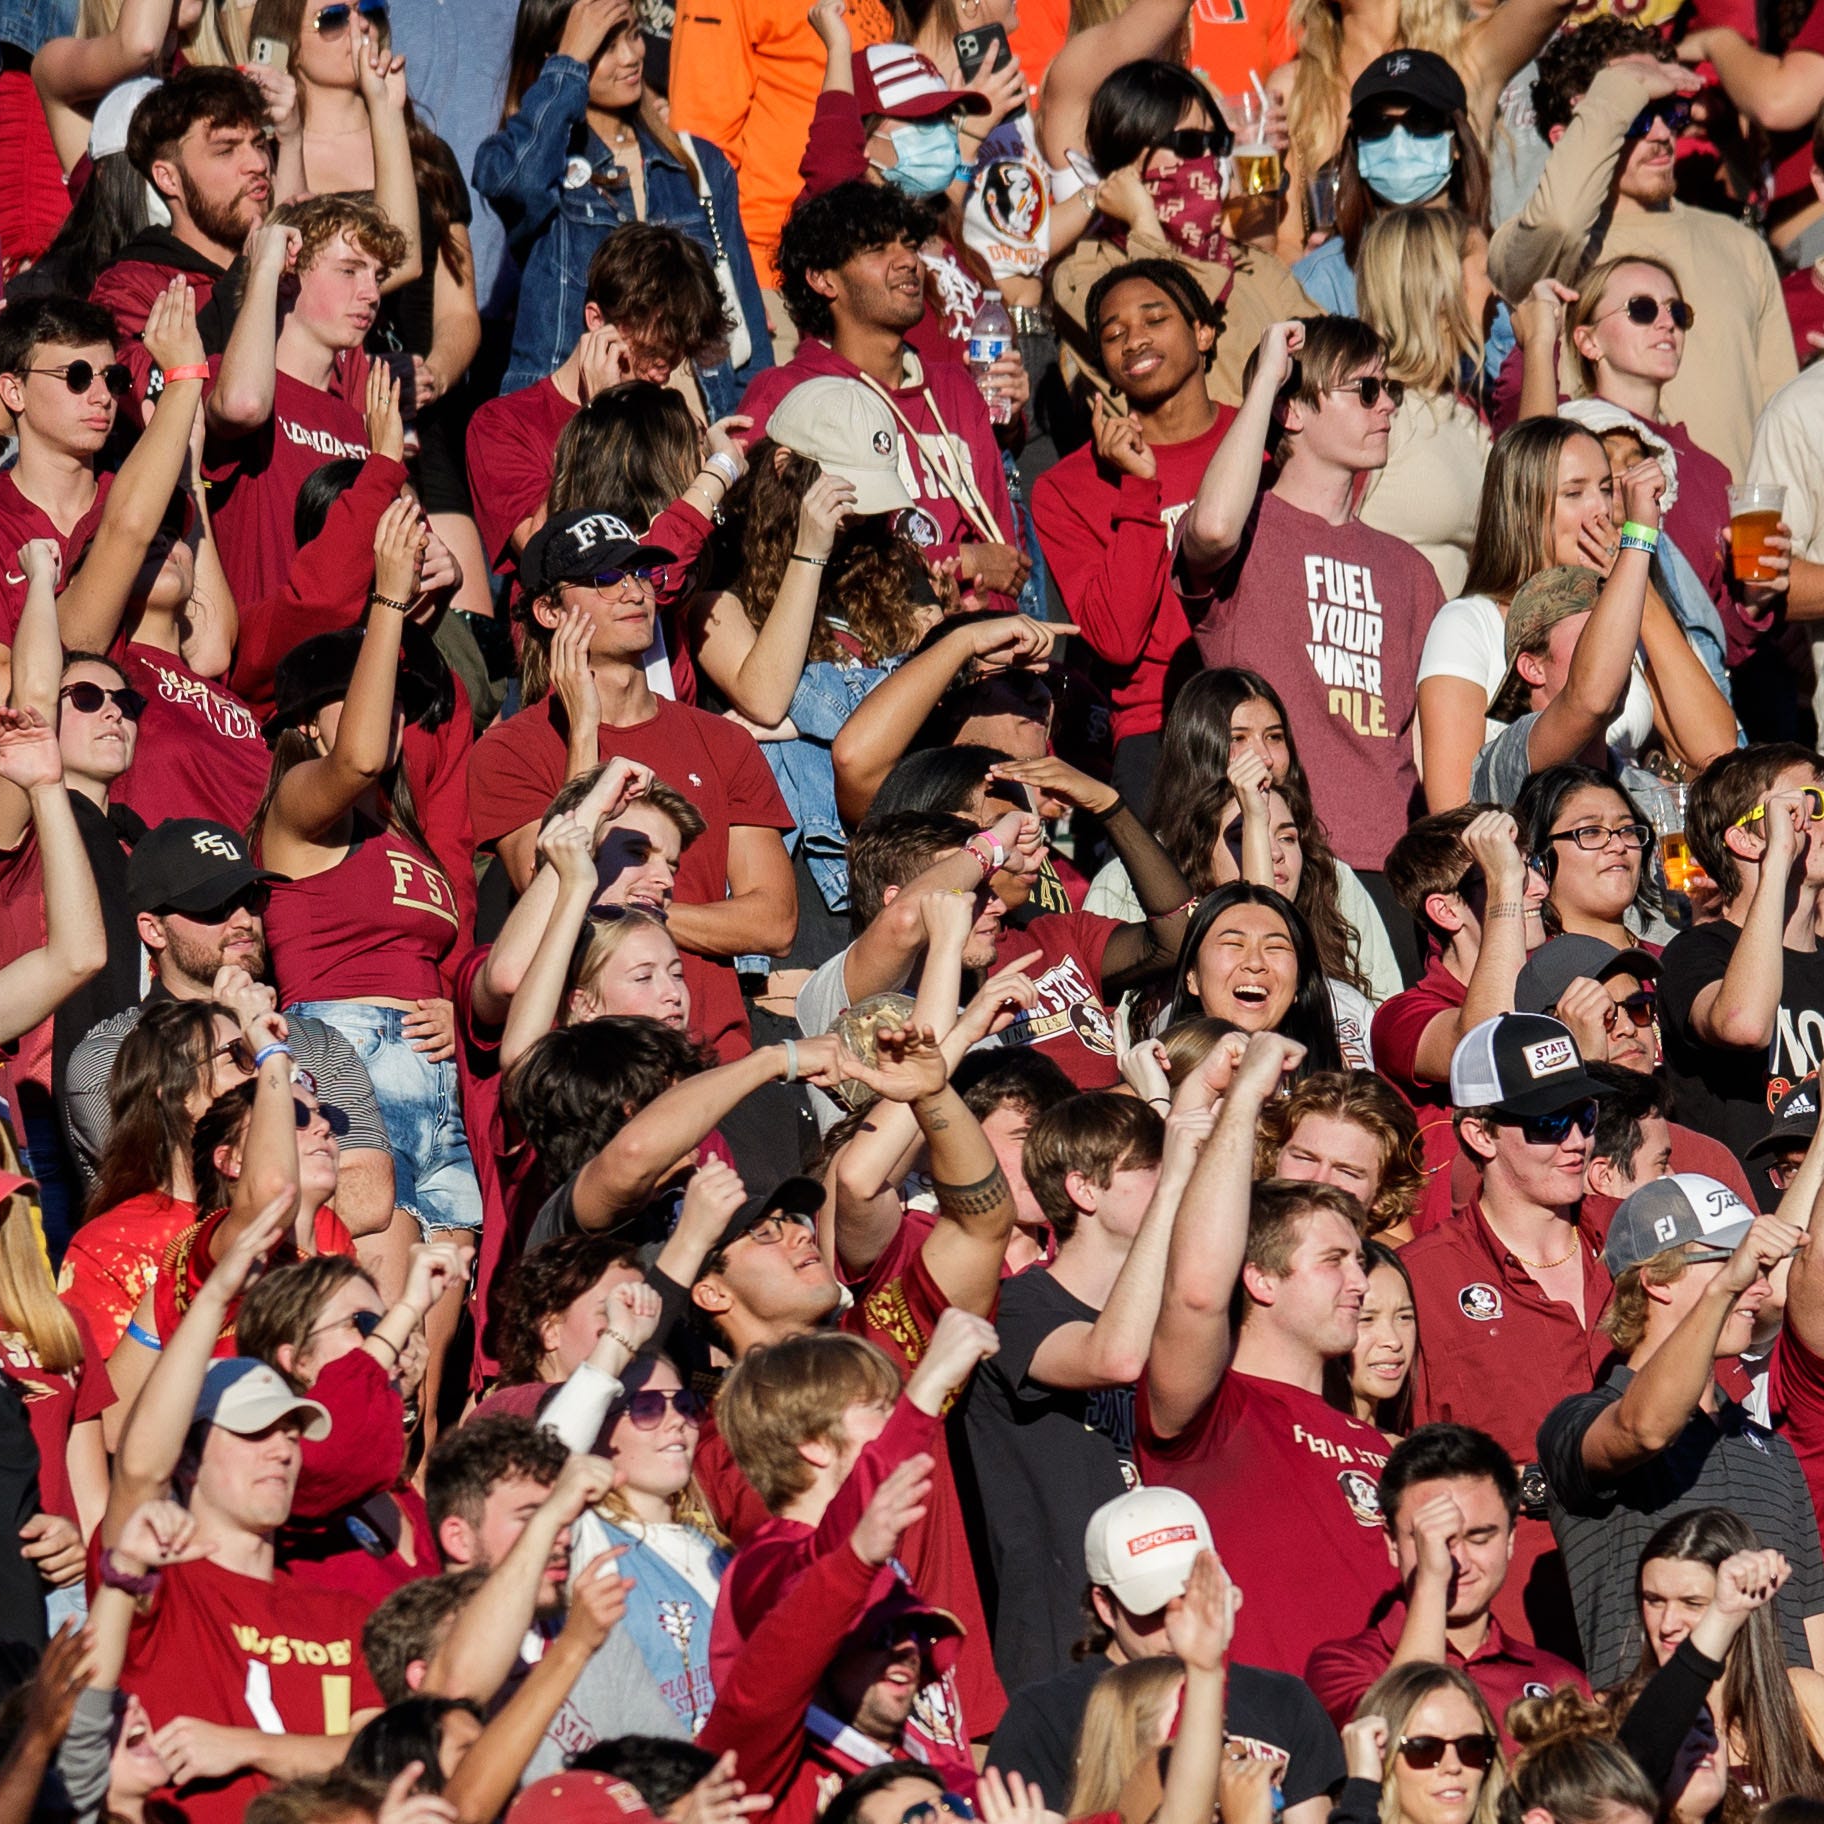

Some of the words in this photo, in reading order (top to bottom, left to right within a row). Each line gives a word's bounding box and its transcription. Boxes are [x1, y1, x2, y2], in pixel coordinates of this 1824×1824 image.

[566, 514, 640, 552] FBI
[1304, 555, 1382, 615] FUEL
[1307, 601, 1384, 656] YOUR
[191, 831, 242, 861] FSU
[1535, 1041, 1569, 1069] STATE
[1783, 1104, 1817, 1118] adidas
[1654, 1214, 1678, 1243] FJ
[555, 1712, 600, 1757] STAT
